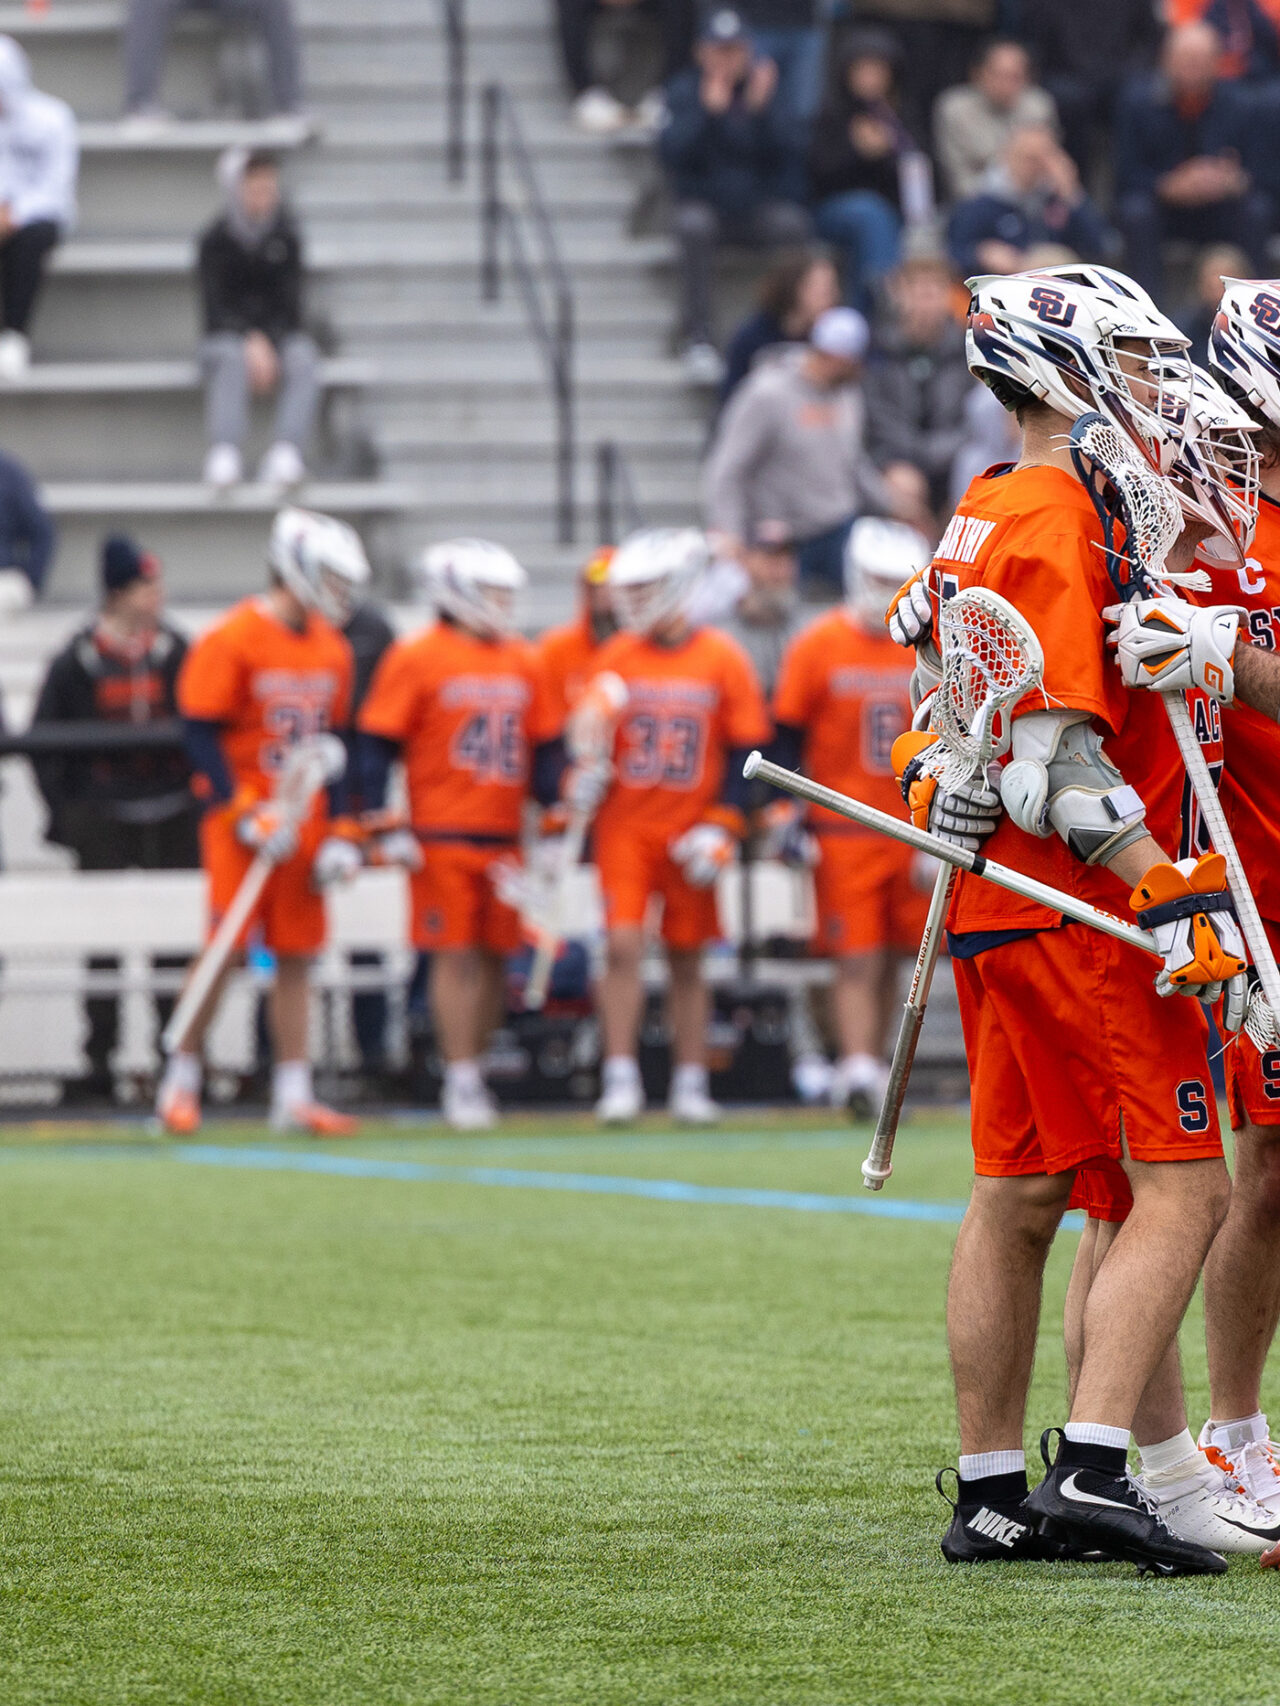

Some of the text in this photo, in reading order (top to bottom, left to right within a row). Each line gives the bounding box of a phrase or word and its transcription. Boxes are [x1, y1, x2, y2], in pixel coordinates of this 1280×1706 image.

[1028, 287, 1077, 328] SU
[1236, 557, 1267, 595] C
[1175, 1079, 1209, 1133] S
[967, 1506, 1027, 1548] NIKE
